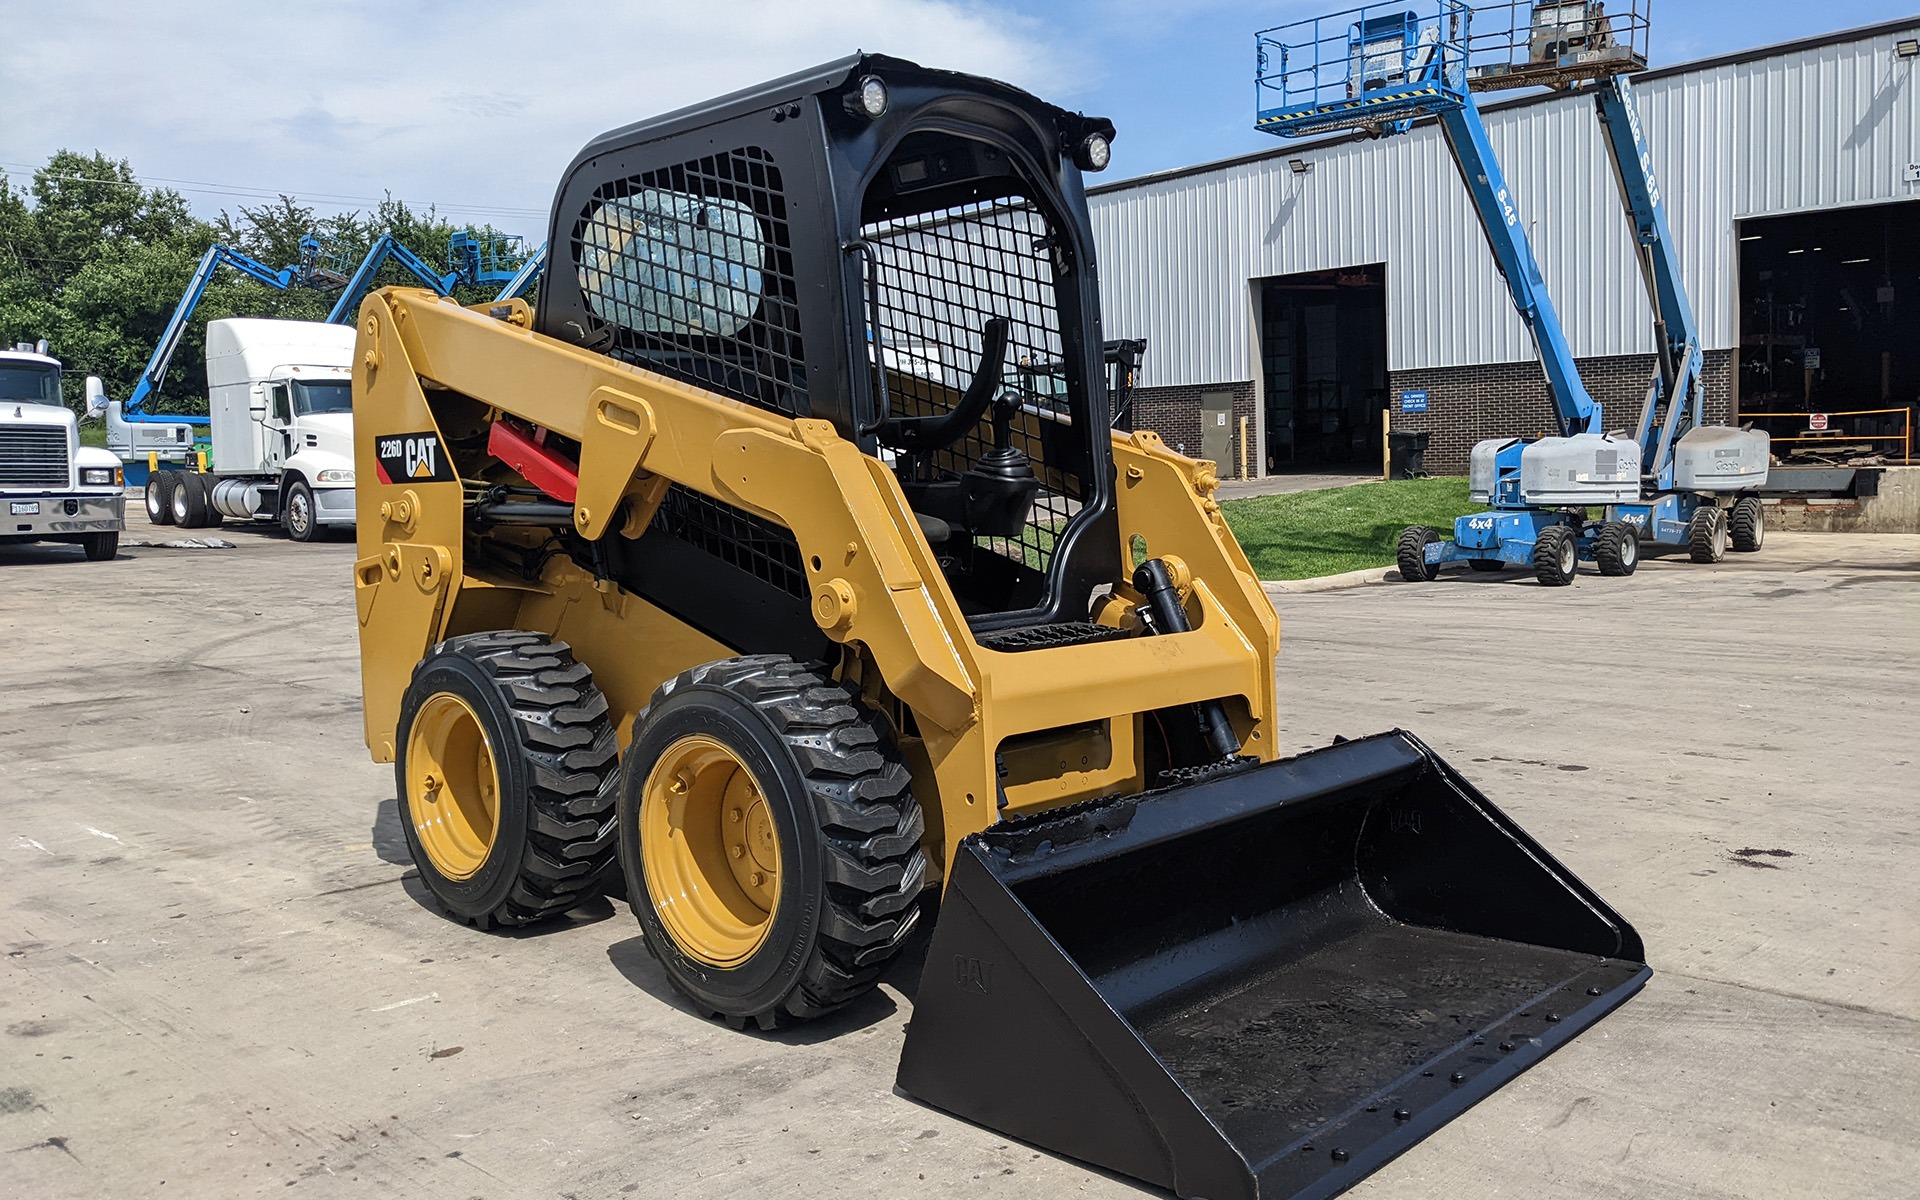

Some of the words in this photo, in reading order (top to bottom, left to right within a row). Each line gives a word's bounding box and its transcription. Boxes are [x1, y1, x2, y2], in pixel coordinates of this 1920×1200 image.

[1620, 77, 1641, 148] Genie
[1640, 151, 1660, 208] S-65
[1497, 188, 1517, 227] S-45
[380, 439, 403, 459] 226D
[405, 437, 437, 478] CAT
[1468, 517, 1493, 530] 4x4
[1622, 513, 1645, 524] 4x4
